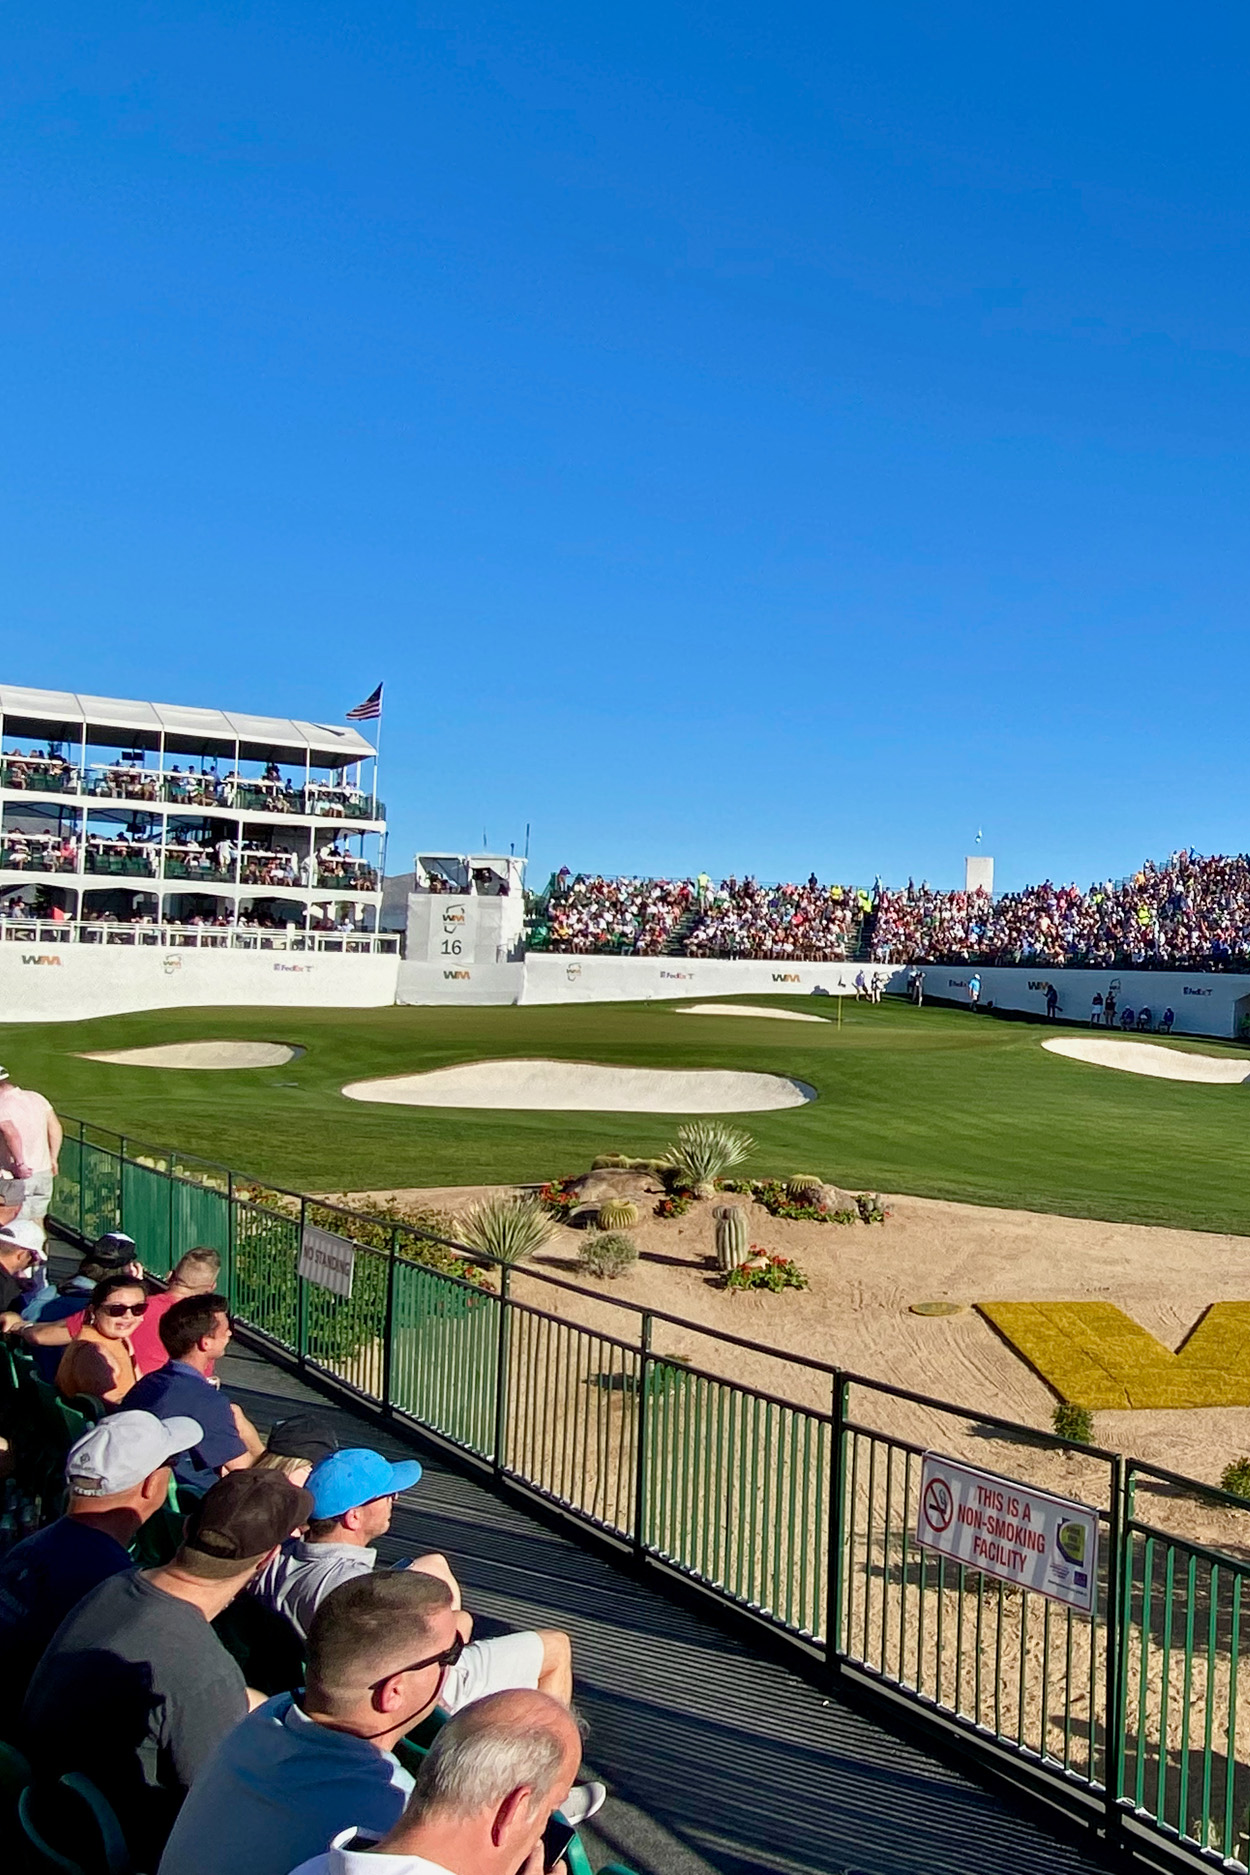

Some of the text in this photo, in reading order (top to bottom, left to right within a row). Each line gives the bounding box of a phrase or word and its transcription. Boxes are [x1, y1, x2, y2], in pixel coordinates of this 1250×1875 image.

[441, 938, 462, 956] 16
[21, 954, 62, 966] WM
[443, 970, 471, 980] WM
[772, 973, 800, 982] WM
[304, 1244, 350, 1277] NO STANDING
[977, 1485, 1032, 1522] THIS IS A
[958, 1504, 1045, 1554] NON-SMOKING
[973, 1536, 1028, 1574] FACILITY
